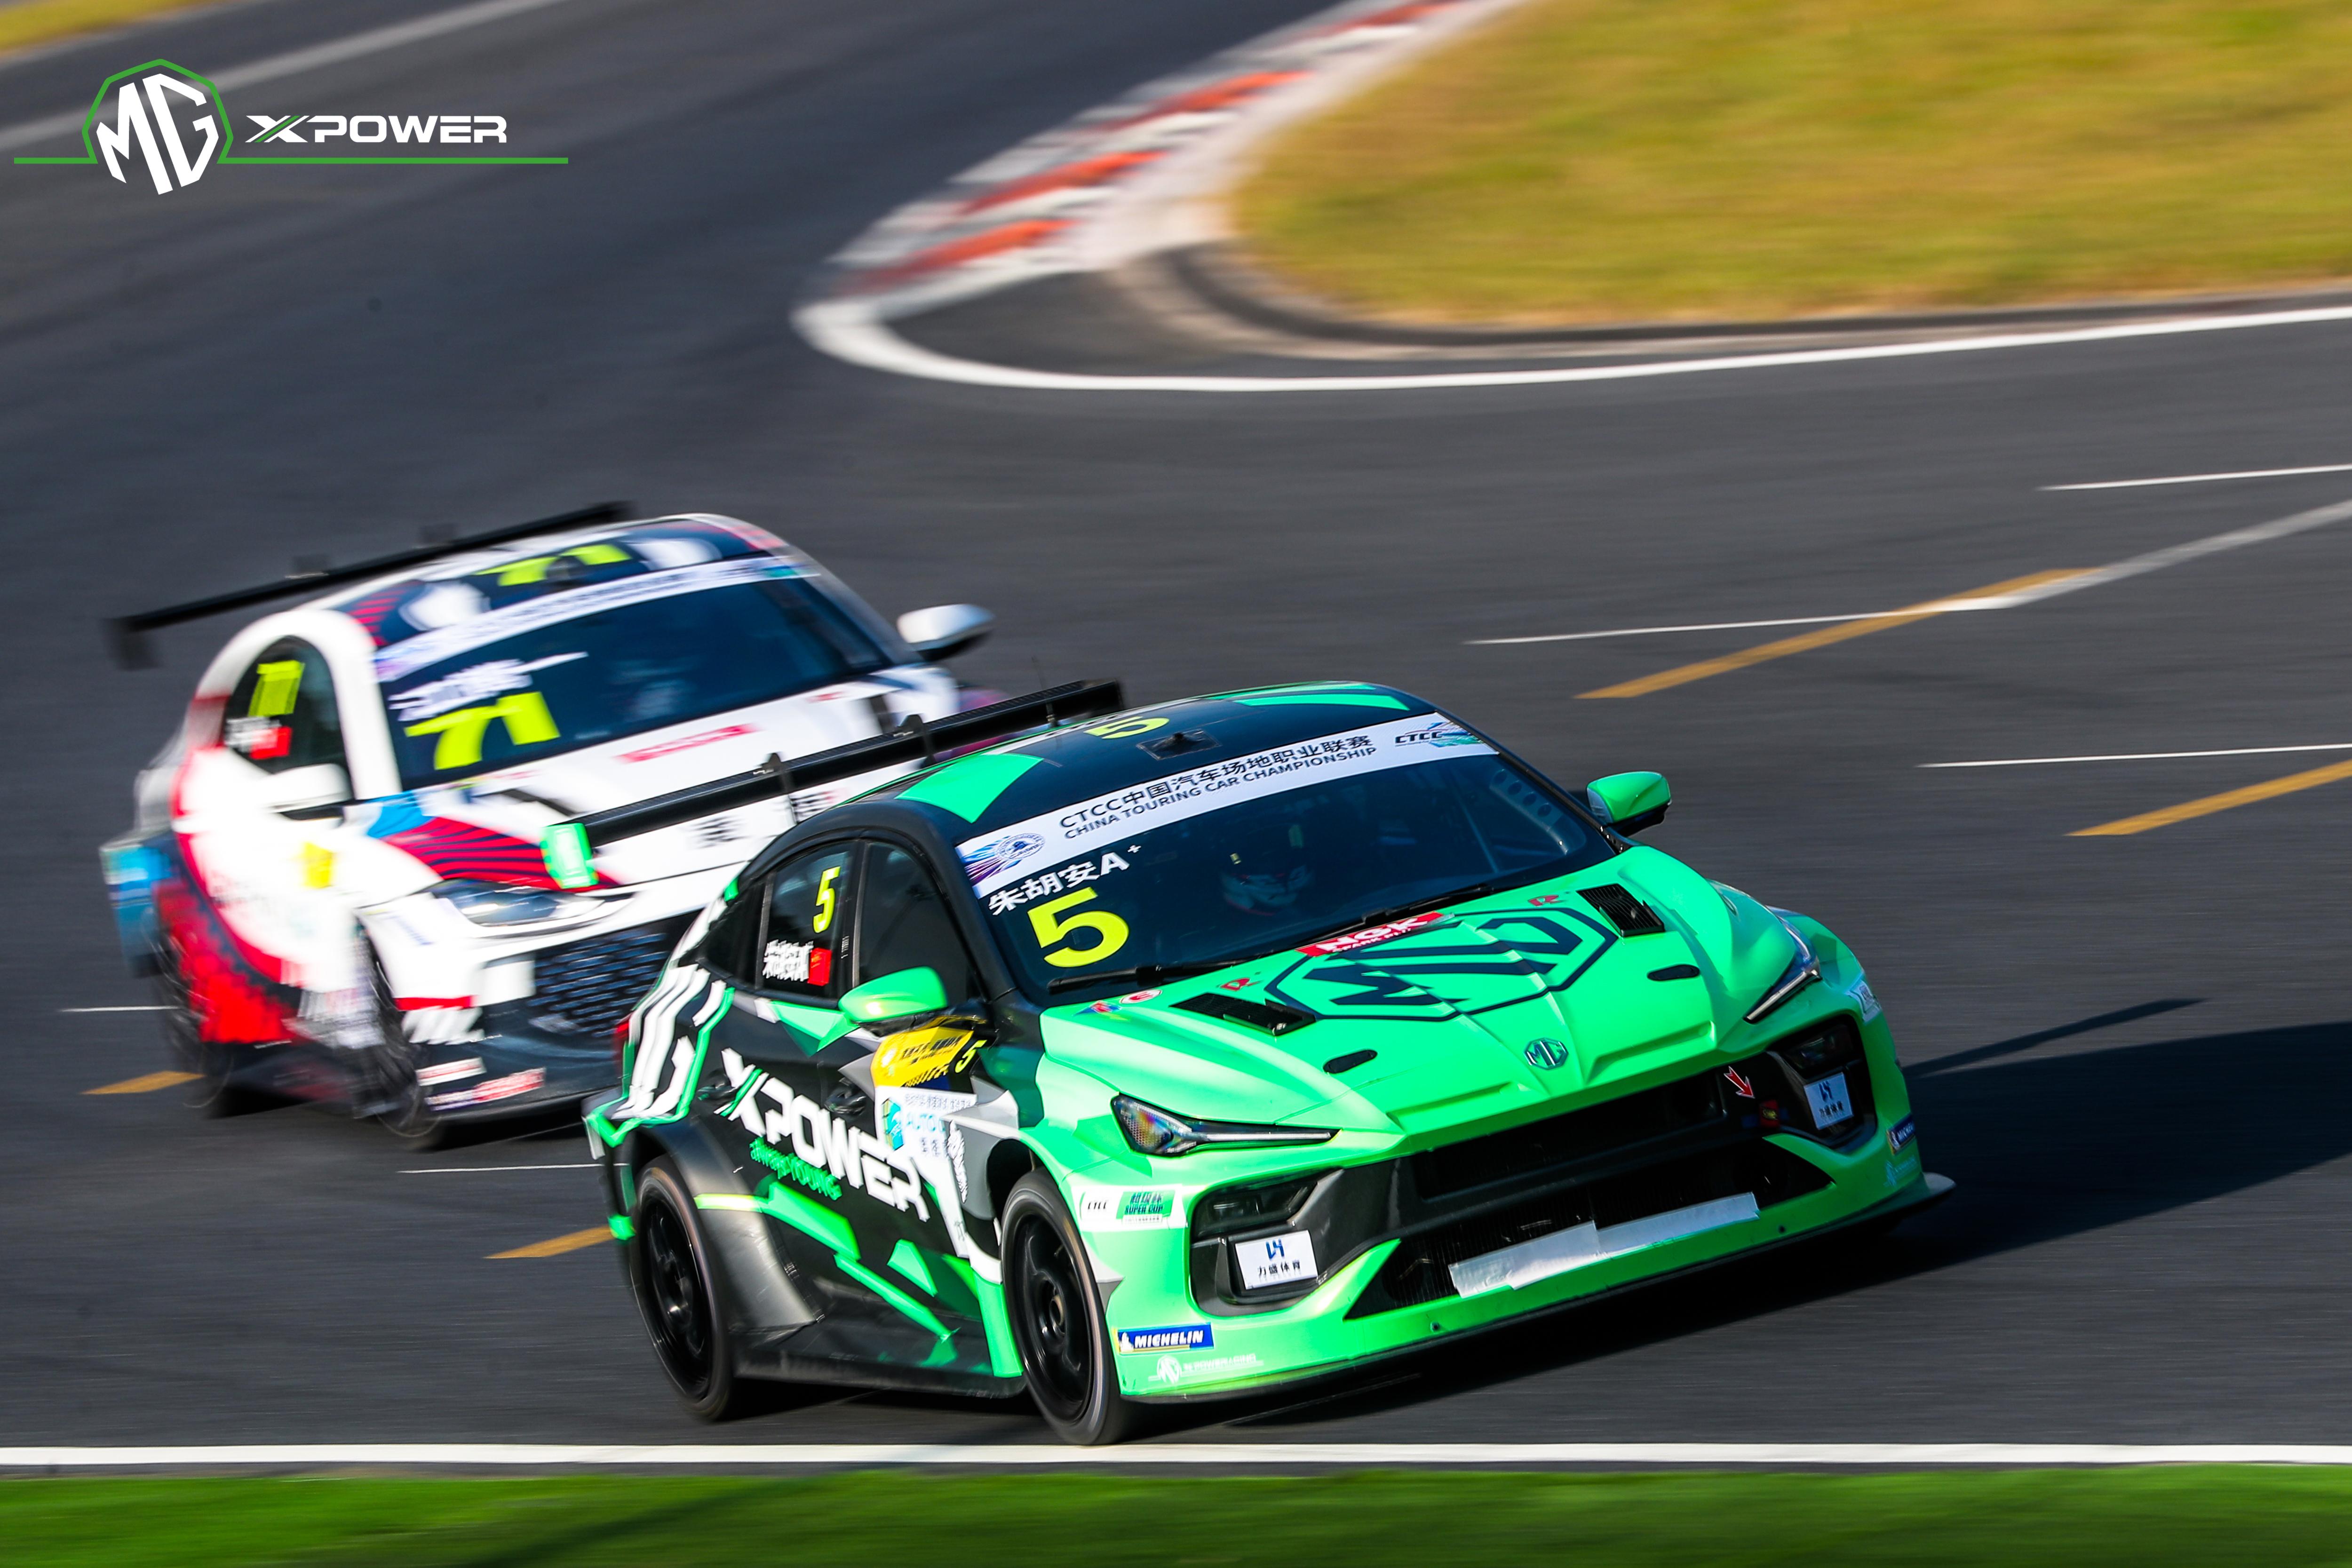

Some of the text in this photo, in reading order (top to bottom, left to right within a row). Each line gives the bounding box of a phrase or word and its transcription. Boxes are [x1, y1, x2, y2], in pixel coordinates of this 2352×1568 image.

[1083, 716, 1170, 740] 5
[1395, 731, 1443, 744] CTCC
[1064, 747, 1377, 839] CHINA TOURING CAR CHAMPIONSHIP
[813, 866, 841, 933] 5
[1027, 887, 1129, 968] 5
[1315, 917, 1428, 952] NGK
[955, 1040, 987, 1074] 5
[1528, 1039, 1565, 1067] MG
[713, 1047, 930, 1223] XPOWER
[1133, 1329, 1204, 1349] MICHELIN
